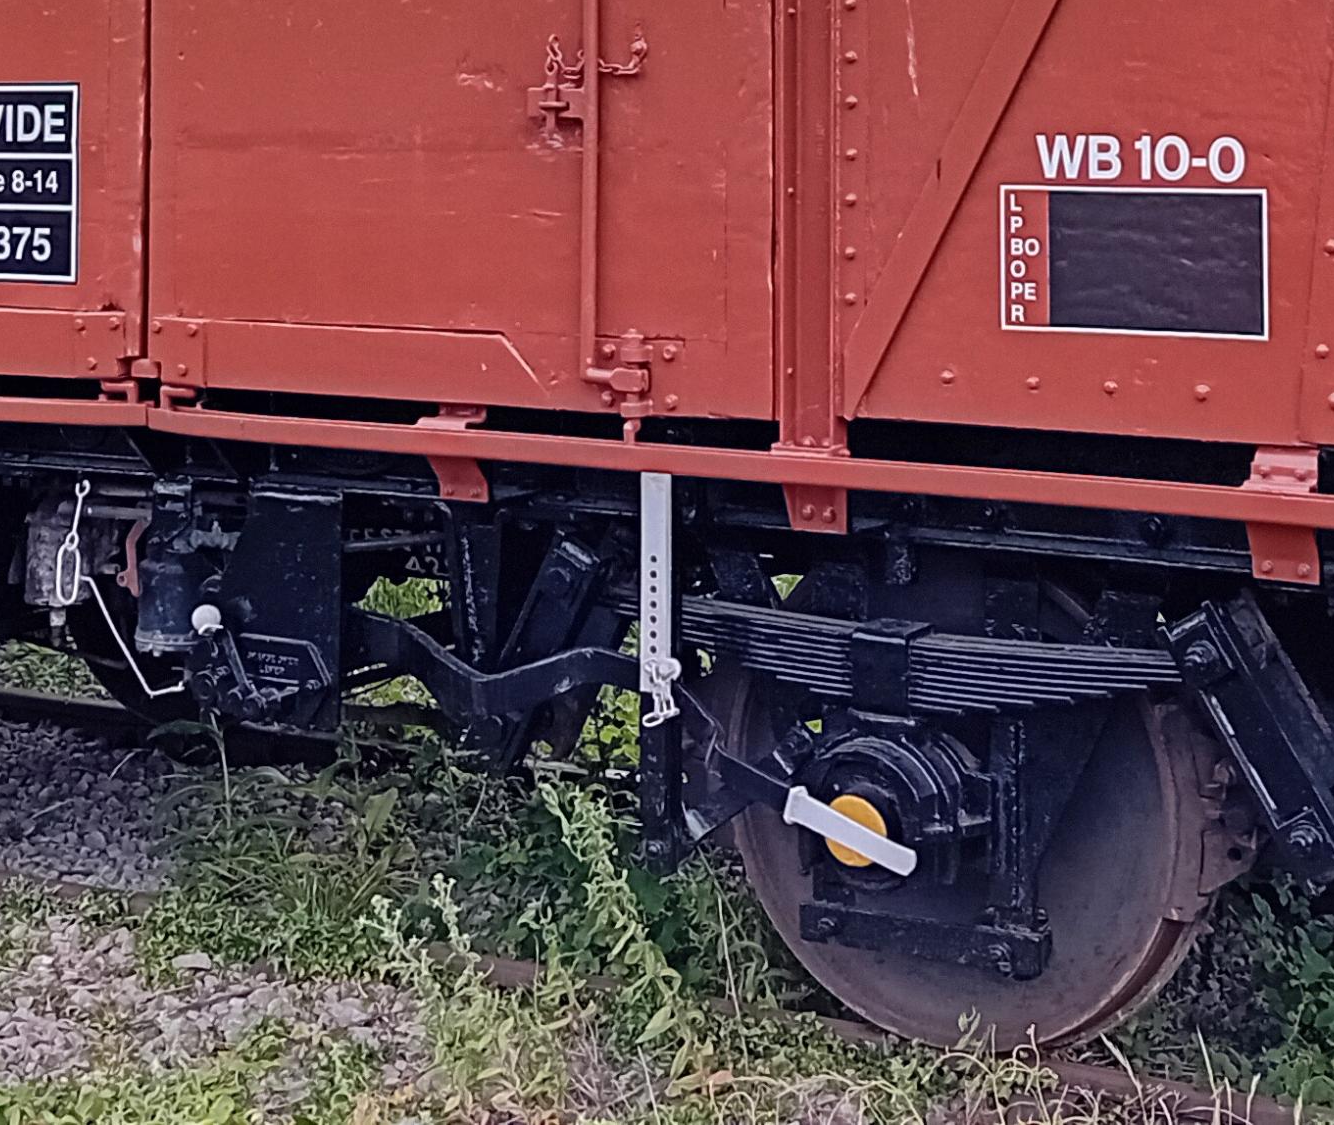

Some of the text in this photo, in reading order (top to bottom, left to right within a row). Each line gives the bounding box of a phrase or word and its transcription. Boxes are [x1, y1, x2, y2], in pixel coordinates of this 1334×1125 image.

[1035, 134, 1246, 184] WB 10-0
[11, 170, 59, 194] 8-14
[1009, 193, 1023, 212] L
[1009, 216, 1024, 234] P
[1009, 238, 1040, 257] BO
[1009, 260, 1027, 279] O
[1010, 282, 1037, 301] PE
[1010, 304, 1025, 323] R
